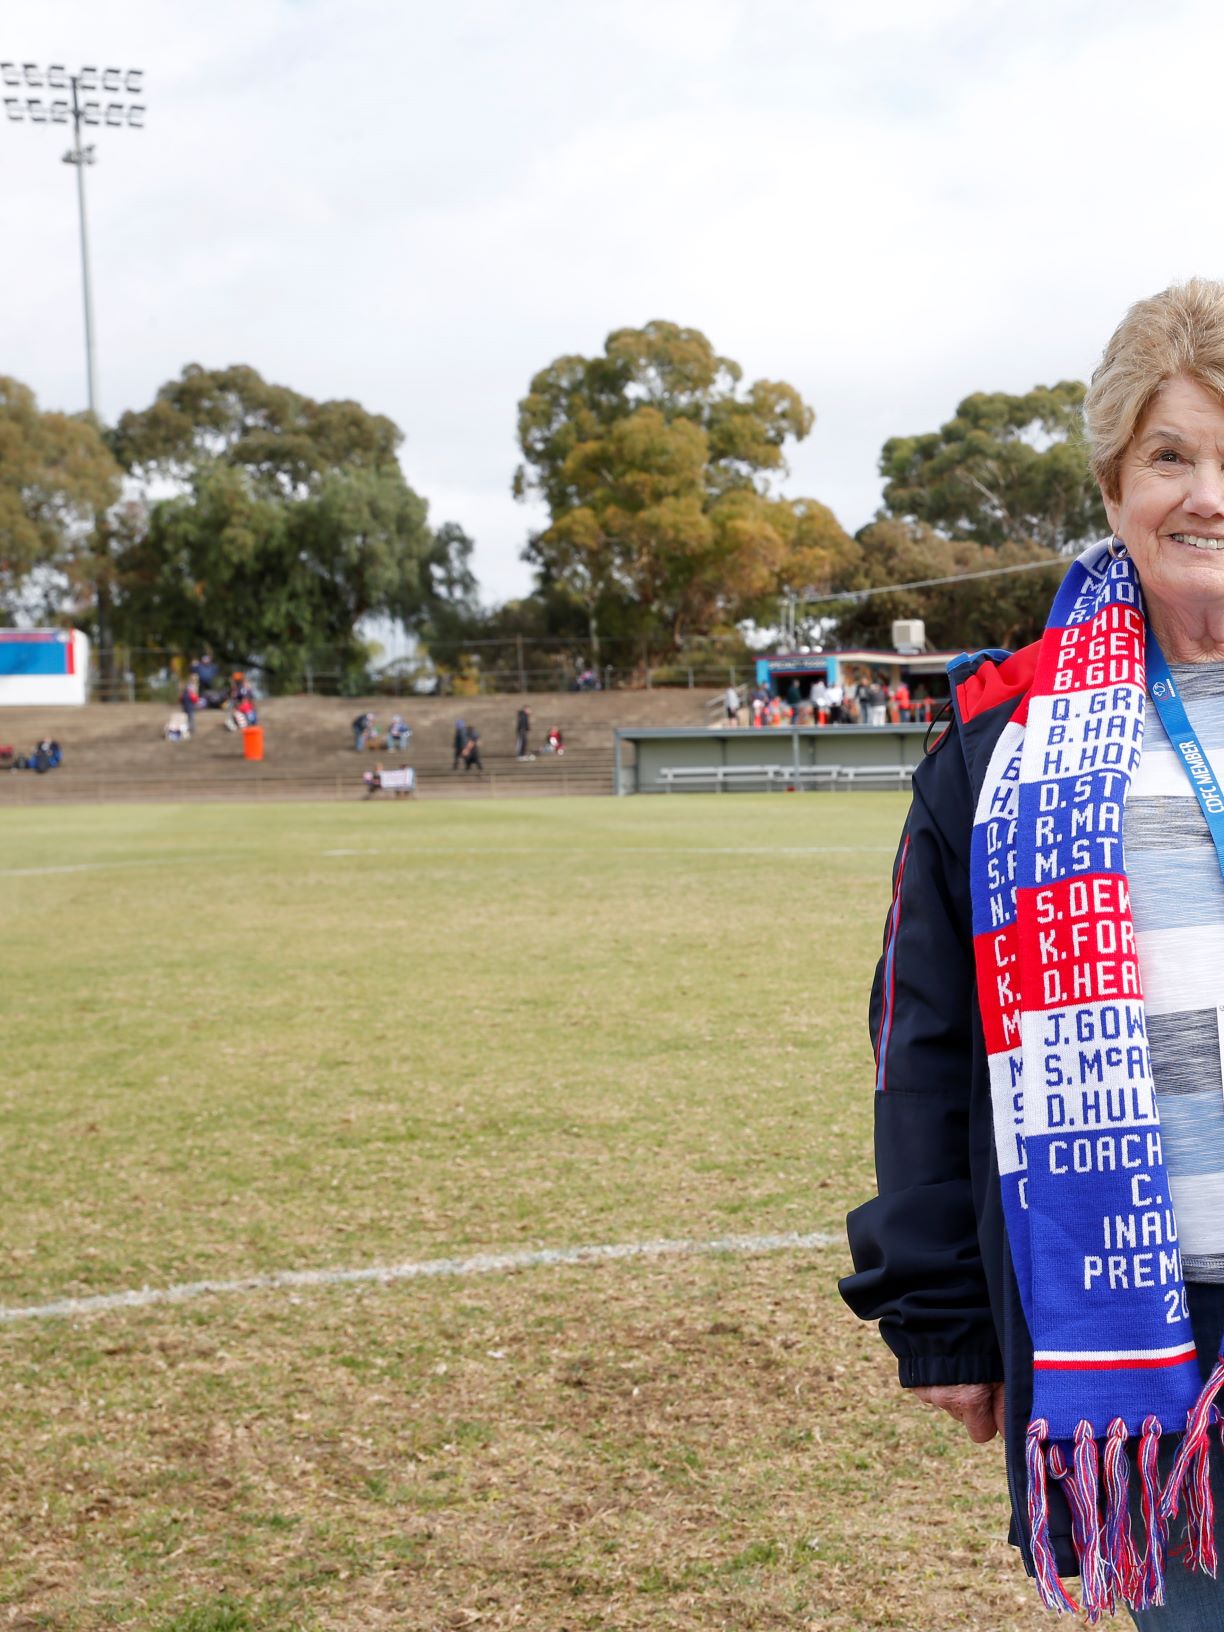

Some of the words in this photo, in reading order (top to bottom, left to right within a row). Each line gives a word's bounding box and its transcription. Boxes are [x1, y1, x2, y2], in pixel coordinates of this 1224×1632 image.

[1060, 606, 1144, 647] D.HIC
[1057, 632, 1145, 669] P.GEI
[1180, 741, 1213, 785] MEMBER
[1040, 772, 1131, 812] D.ST
[1201, 781, 1224, 814] CDFC
[1035, 837, 1127, 883] M.ST
[1043, 961, 1144, 1005] D.HEA
[1044, 1046, 1152, 1087] S.McA
[1047, 1087, 1157, 1128] D.HUL
[1049, 1132, 1163, 1176] COACH
[1083, 1248, 1184, 1291] PREM
